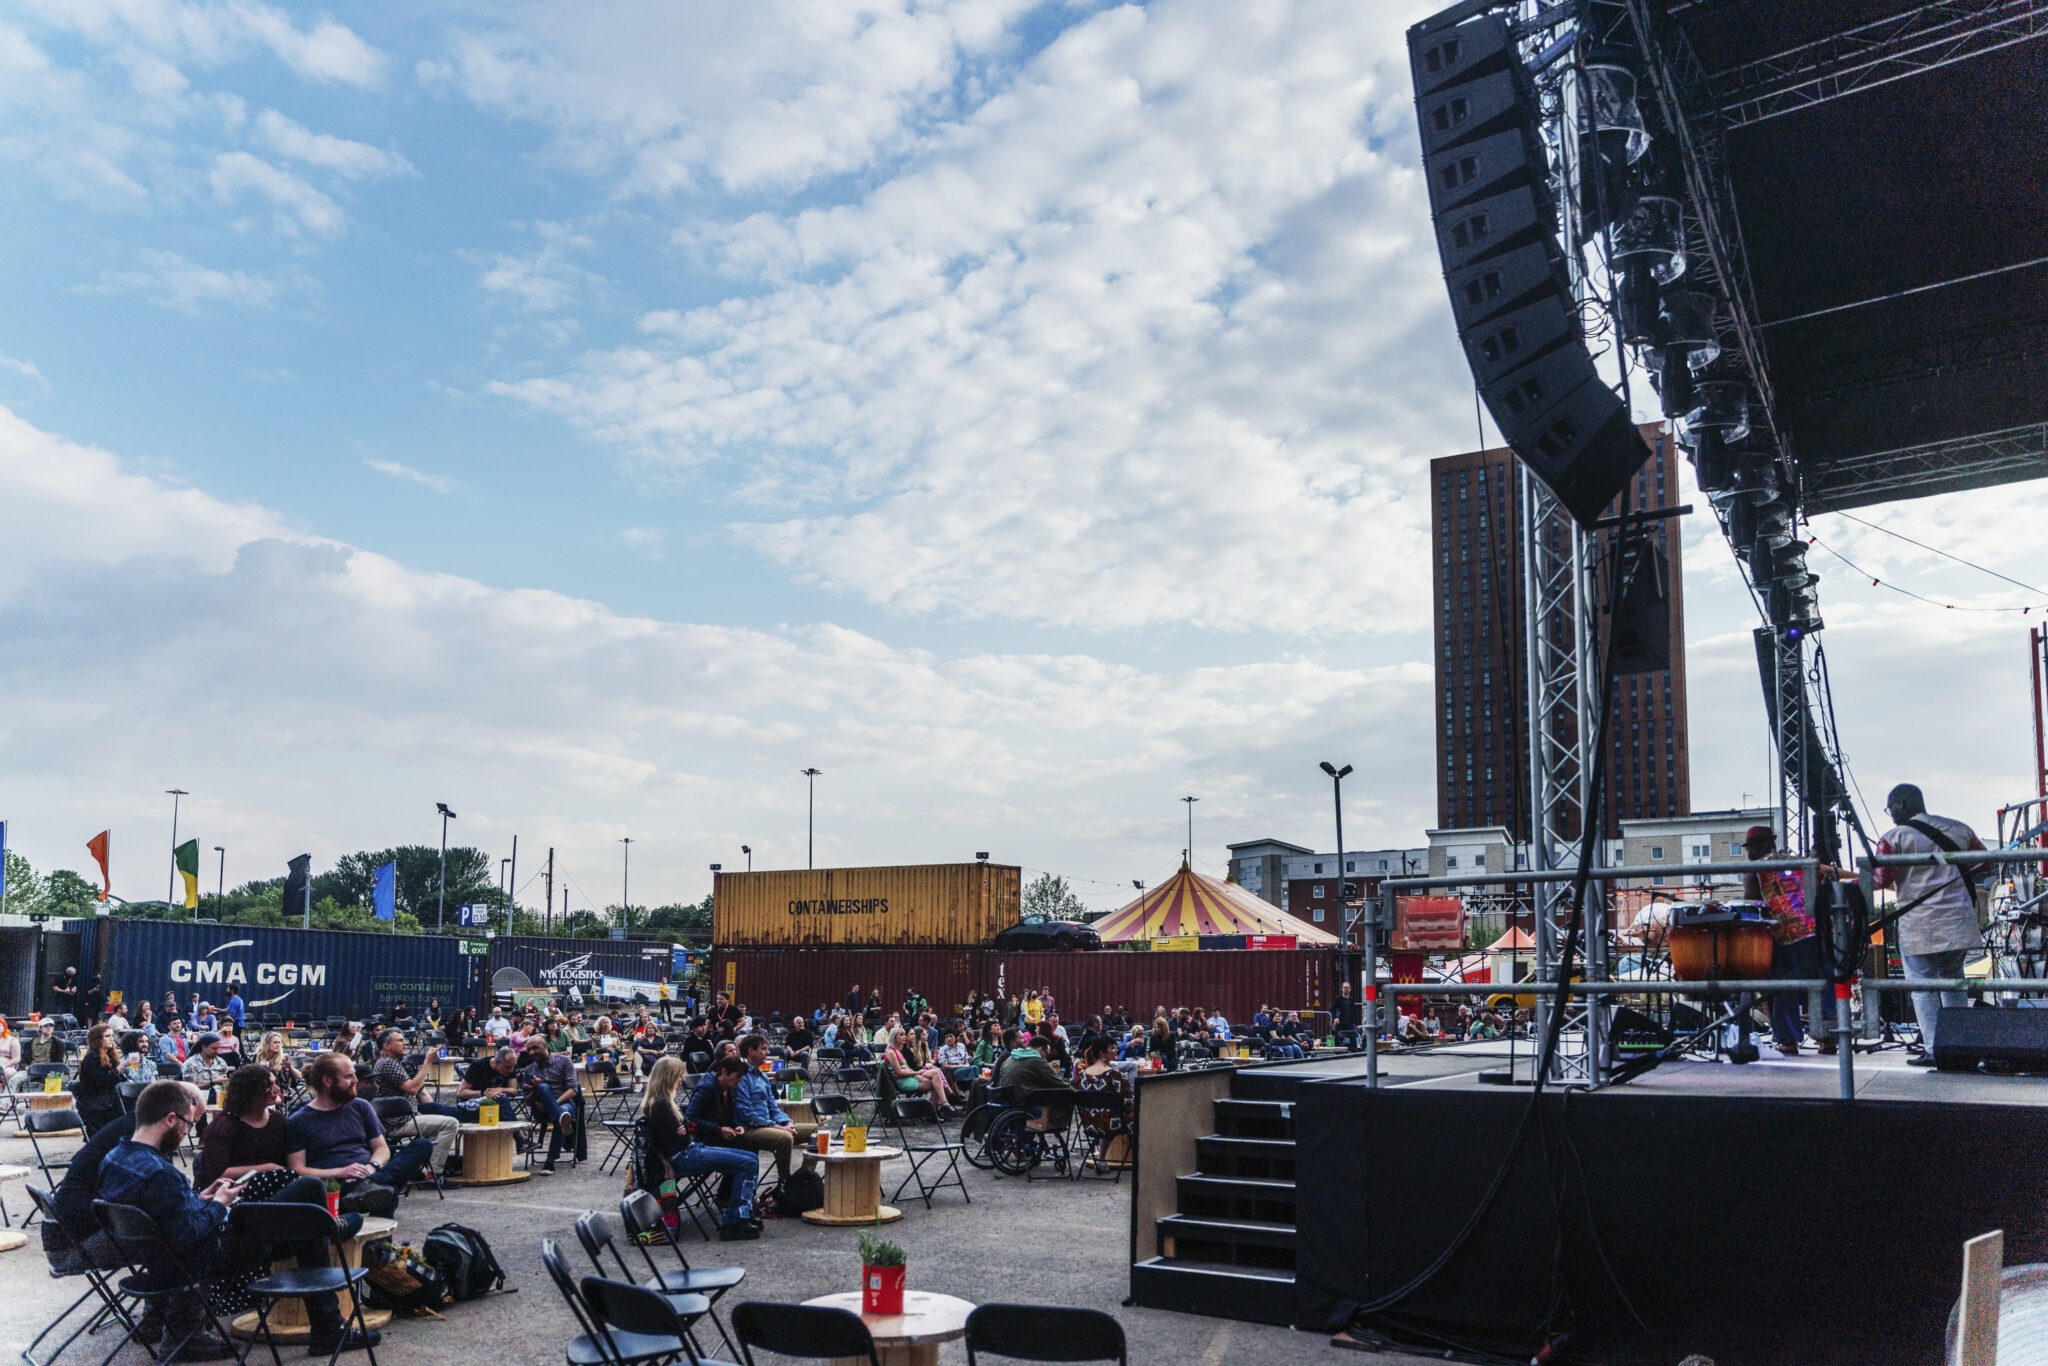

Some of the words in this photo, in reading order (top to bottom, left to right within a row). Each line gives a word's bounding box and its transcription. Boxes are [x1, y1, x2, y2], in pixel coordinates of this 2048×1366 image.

[788, 898, 889, 915] CONTAINERSHIPS
[461, 906, 470, 925] P
[471, 946, 487, 954] exit
[170, 960, 247, 984] CMA
[257, 963, 326, 986] CGM
[539, 969, 558, 979] NYK
[560, 969, 604, 979] LOGISTICS
[374, 982, 397, 991] eco
[399, 981, 455, 992] container
